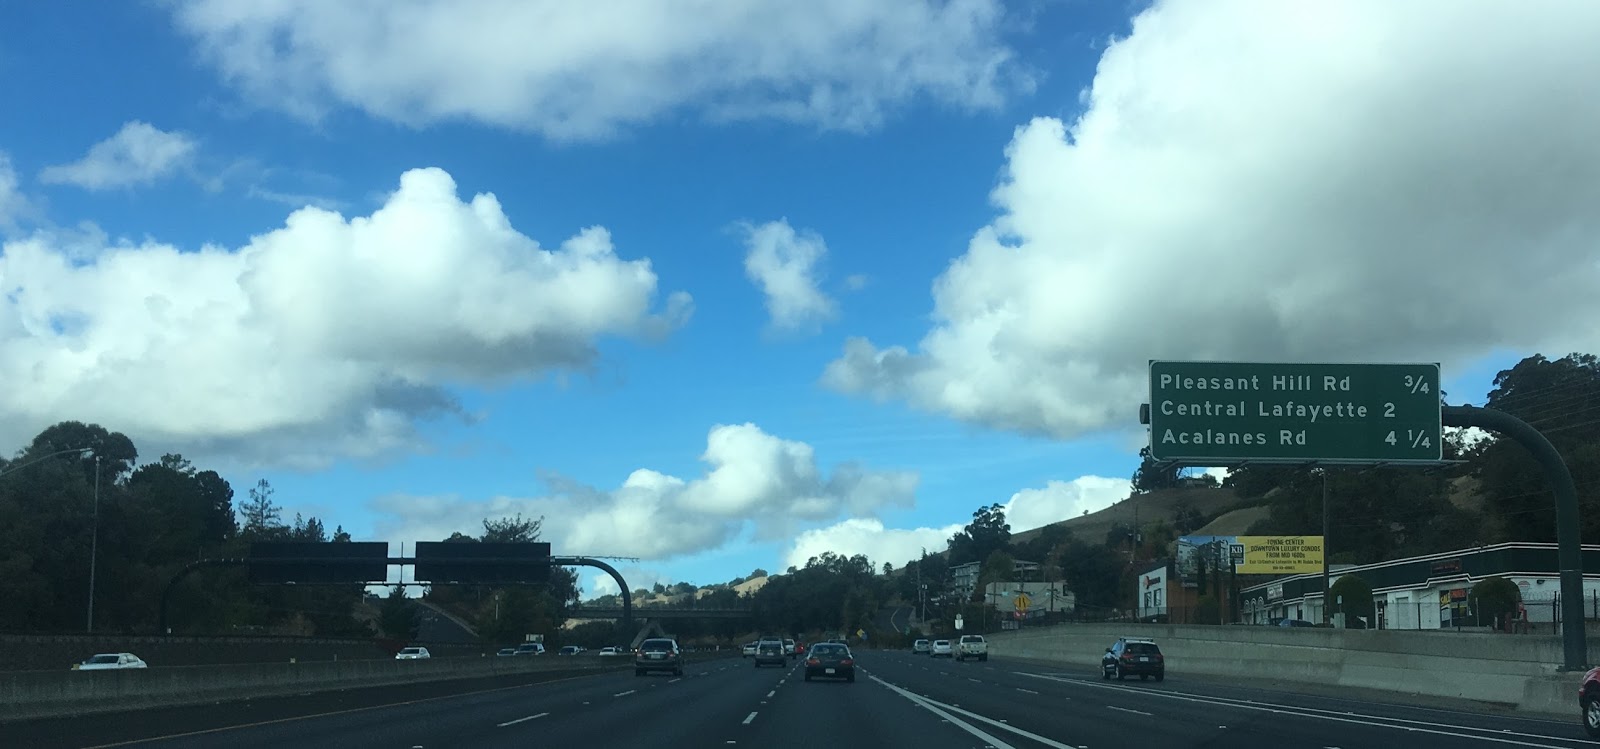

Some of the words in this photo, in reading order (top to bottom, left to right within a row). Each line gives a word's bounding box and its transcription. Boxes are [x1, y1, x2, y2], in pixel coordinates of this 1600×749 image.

[1160, 374, 1259, 391] Pleasant
[1272, 375, 1311, 391] Hill
[1323, 376, 1350, 391] Rd
[1160, 400, 1245, 416] Central
[1259, 401, 1367, 422] Lafayette
[1384, 402, 1396, 418] 2
[1162, 429, 1267, 445] Acalanes
[1280, 430, 1306, 445] Rd
[1384, 431, 1397, 445] 4
[1231, 546, 1243, 554] KB
